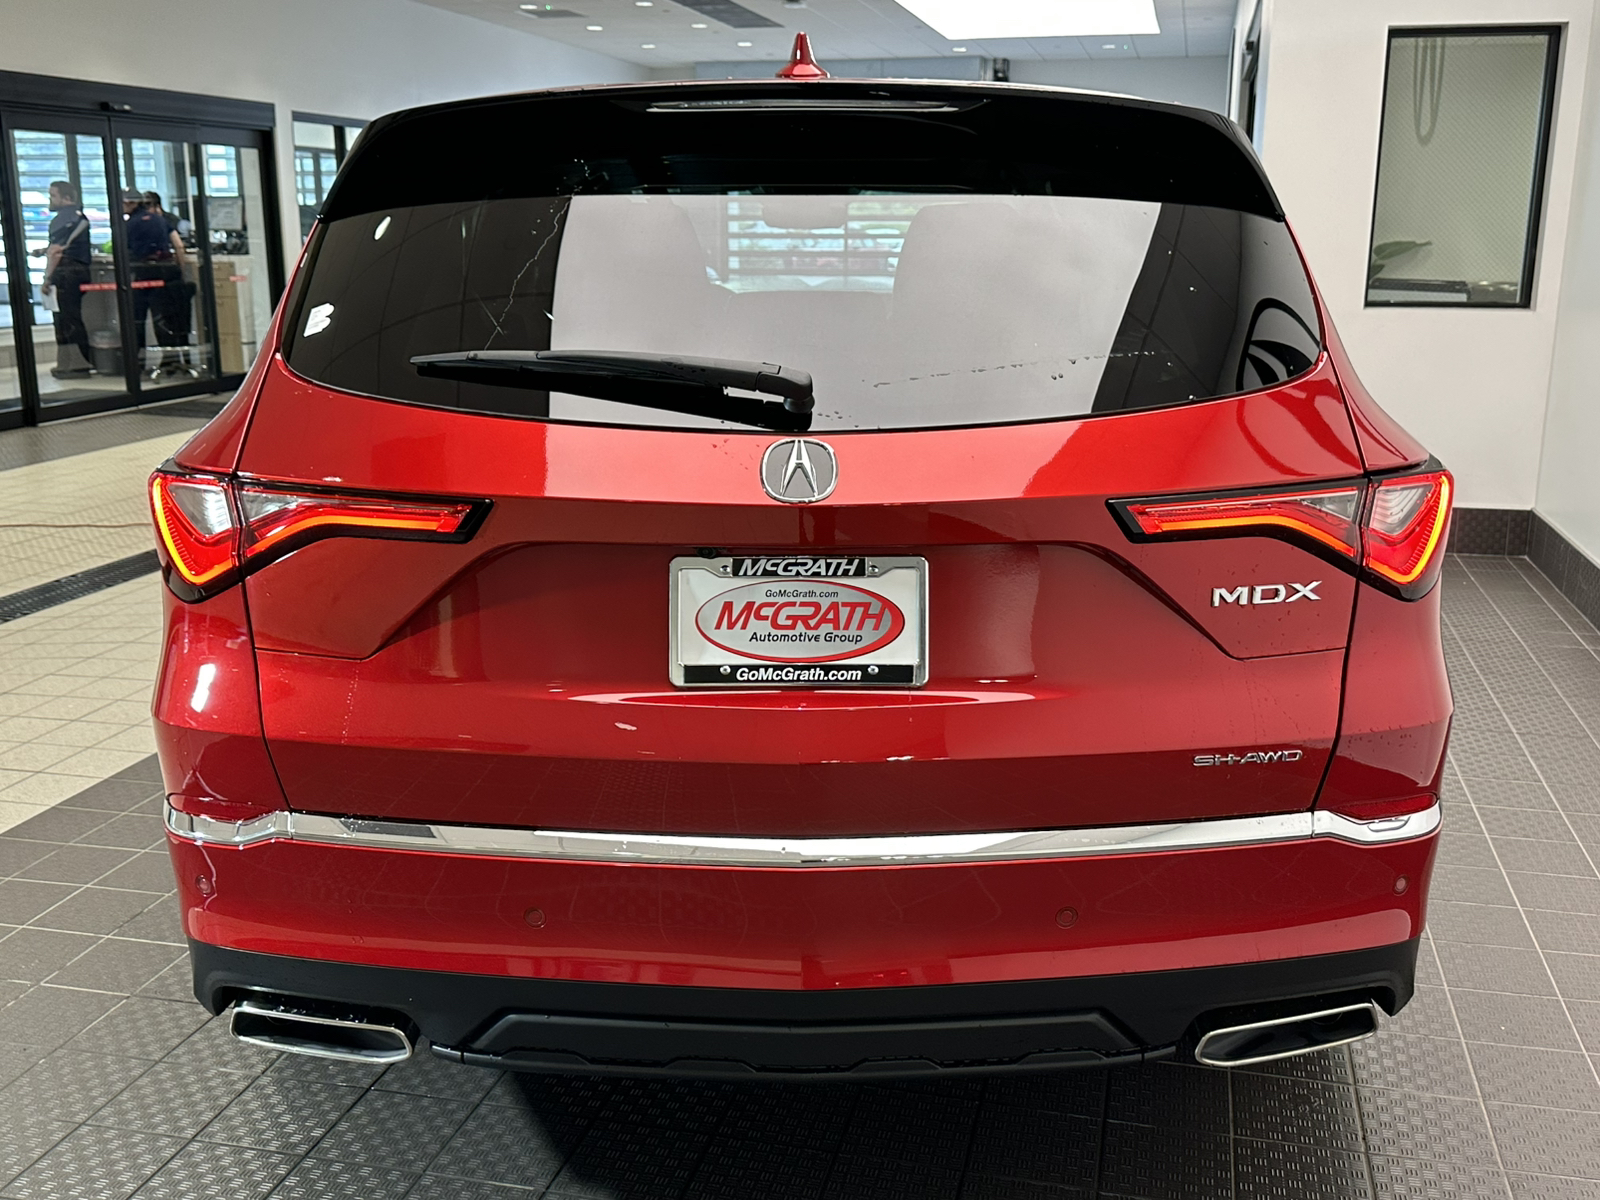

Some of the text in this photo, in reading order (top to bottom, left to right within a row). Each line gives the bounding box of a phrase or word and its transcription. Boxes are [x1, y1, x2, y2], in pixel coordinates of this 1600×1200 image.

[765, 589, 839, 599] GoMcGrath.com
[1212, 580, 1323, 607] MDX
[749, 632, 863, 645] Automotive Group
[736, 668, 862, 681] GoMcGrath.com
[1193, 750, 1303, 766] SH-AWD
